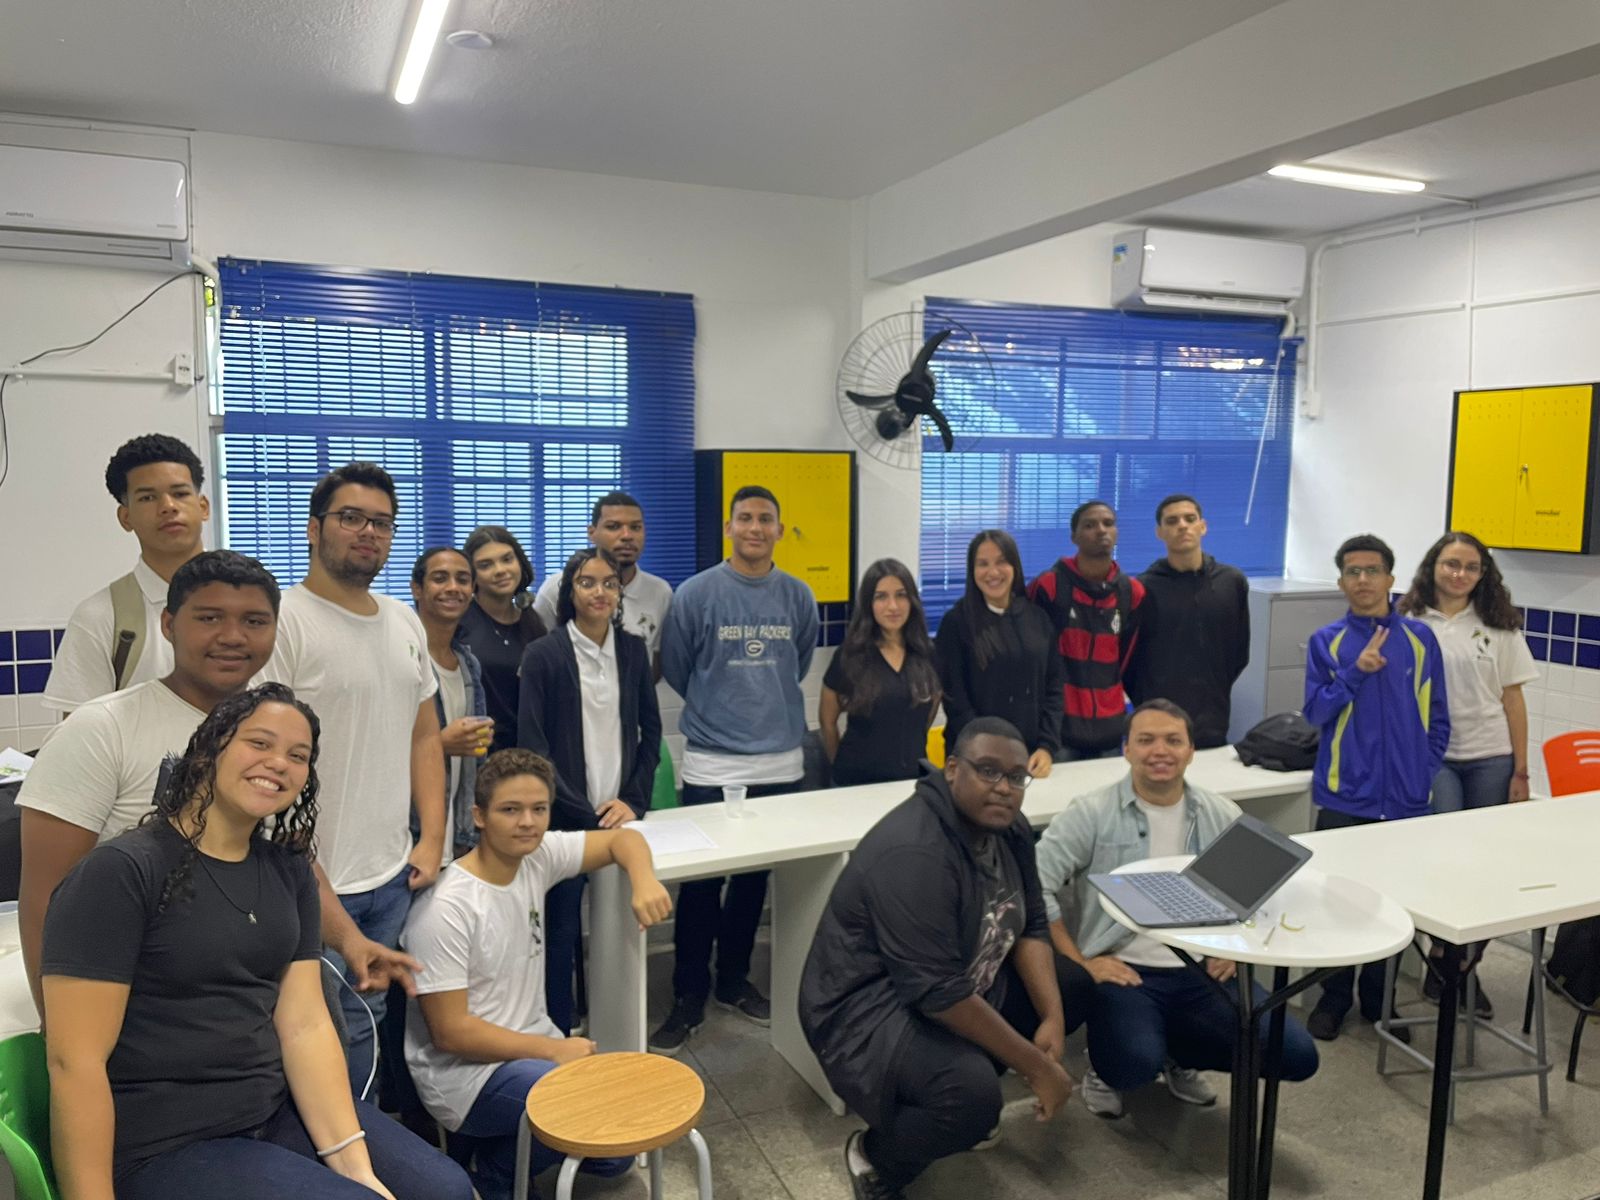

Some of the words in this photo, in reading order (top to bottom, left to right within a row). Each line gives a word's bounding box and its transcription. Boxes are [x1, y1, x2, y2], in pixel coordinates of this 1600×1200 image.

[718, 625, 741, 640] GREEN
[760, 625, 791, 640] PACKERS
[746, 641, 763, 656] G
